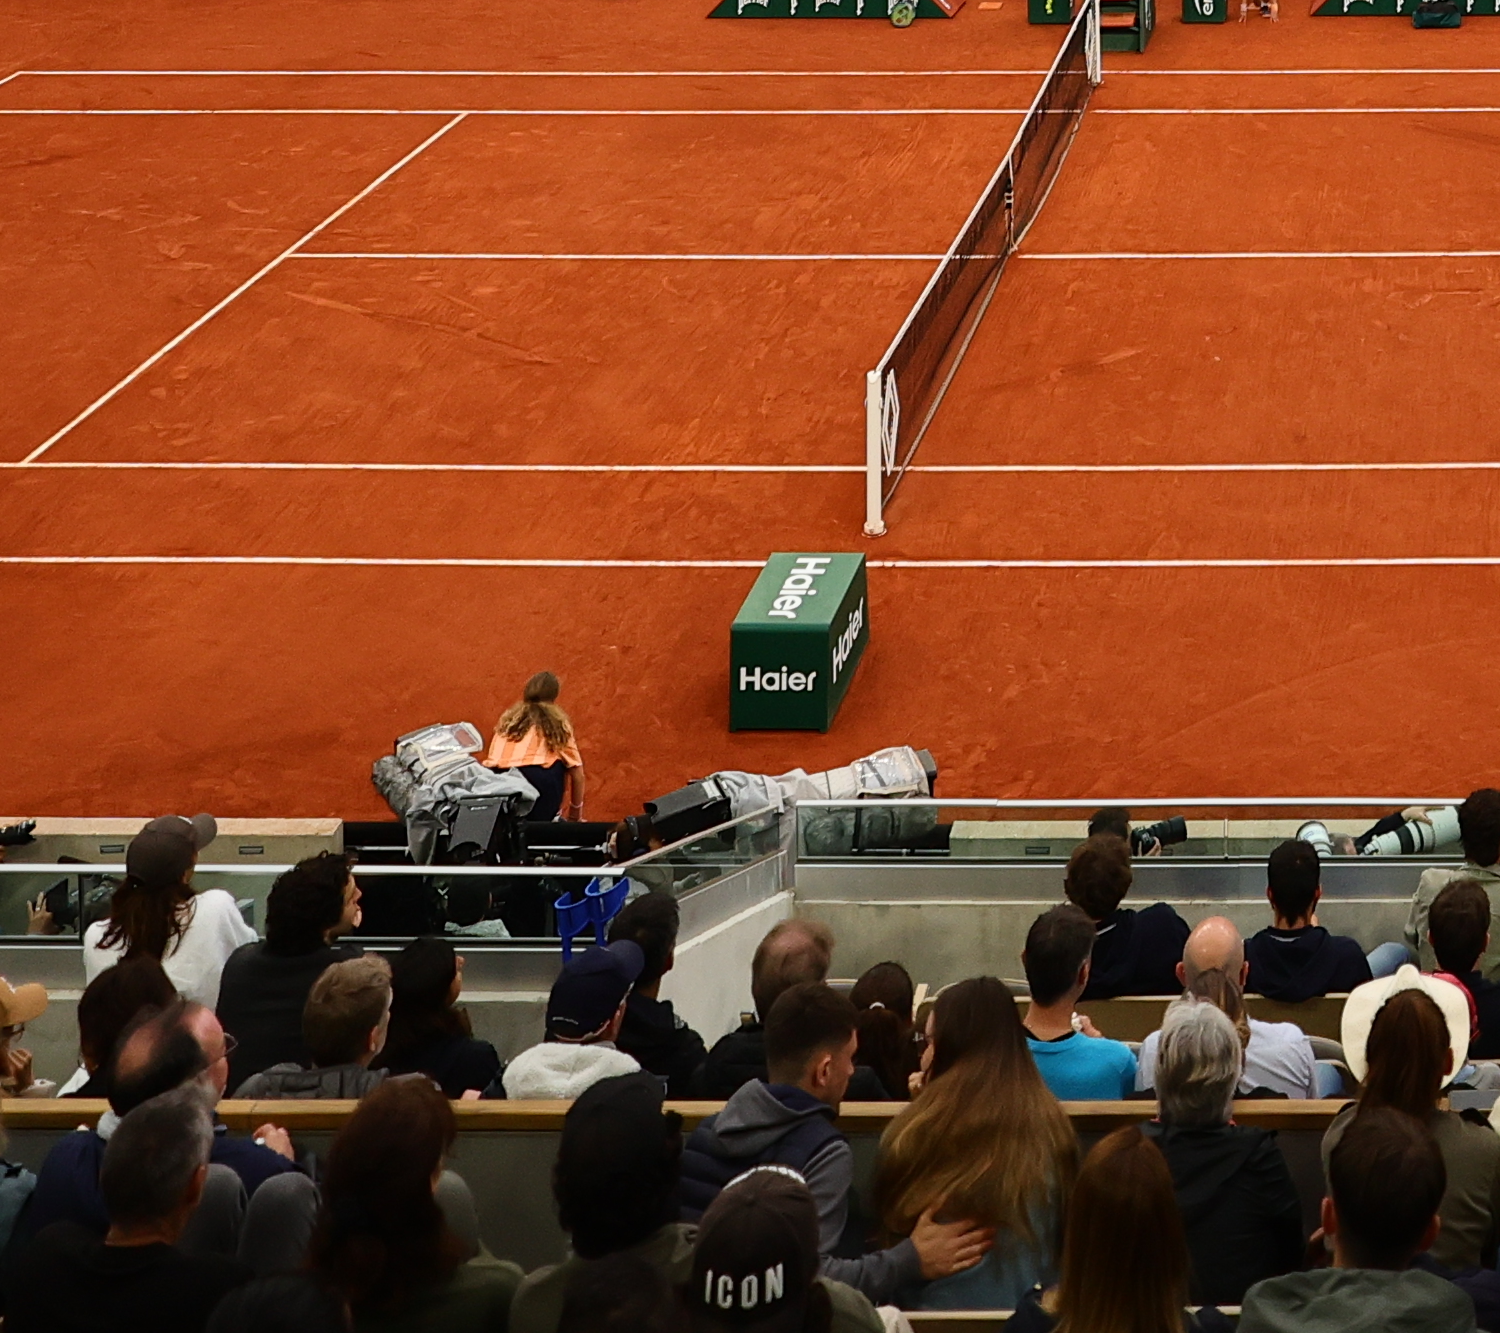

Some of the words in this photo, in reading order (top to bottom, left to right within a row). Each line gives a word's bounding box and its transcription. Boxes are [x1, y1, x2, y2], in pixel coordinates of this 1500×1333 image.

[768, 556, 832, 620] Haier
[831, 596, 865, 685] Haier
[739, 666, 818, 693] Haier
[704, 1261, 785, 1311] ICON
